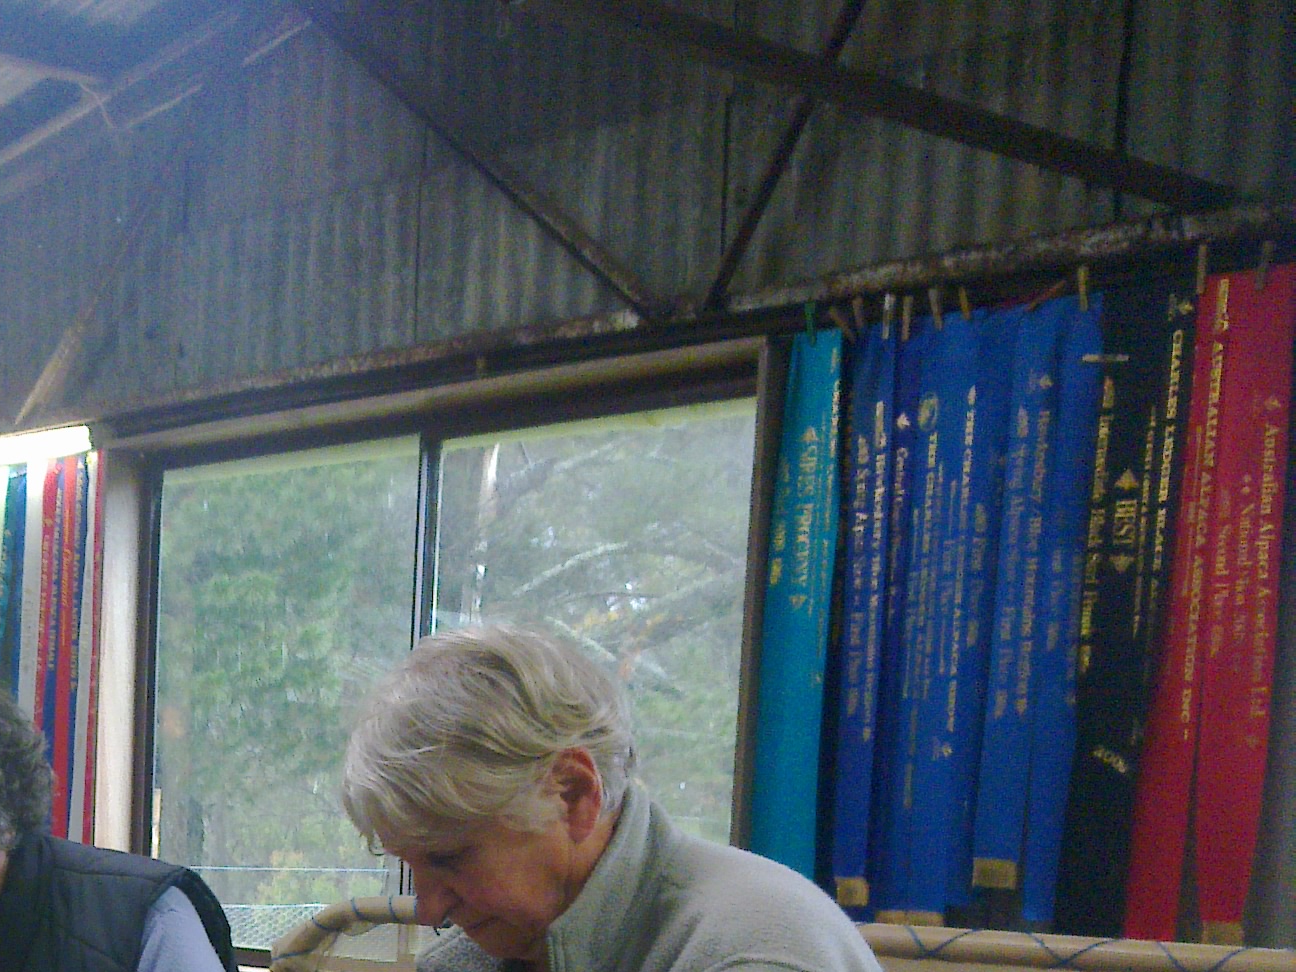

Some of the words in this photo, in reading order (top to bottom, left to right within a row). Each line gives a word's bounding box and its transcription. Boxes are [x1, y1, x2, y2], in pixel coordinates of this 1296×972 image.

[1166, 329, 1184, 420] CHARLES
[1202, 341, 1225, 468] AUSTRALIAN
[1158, 424, 1176, 503] LEDGER
[1260, 423, 1280, 514] Australian
[1112, 500, 1138, 545] BEST
[1195, 472, 1213, 548] ALPACA
[1254, 520, 1275, 579] Alpaca
[1184, 555, 1204, 682] ASSOCIATION
[1180, 688, 1192, 724] INC
